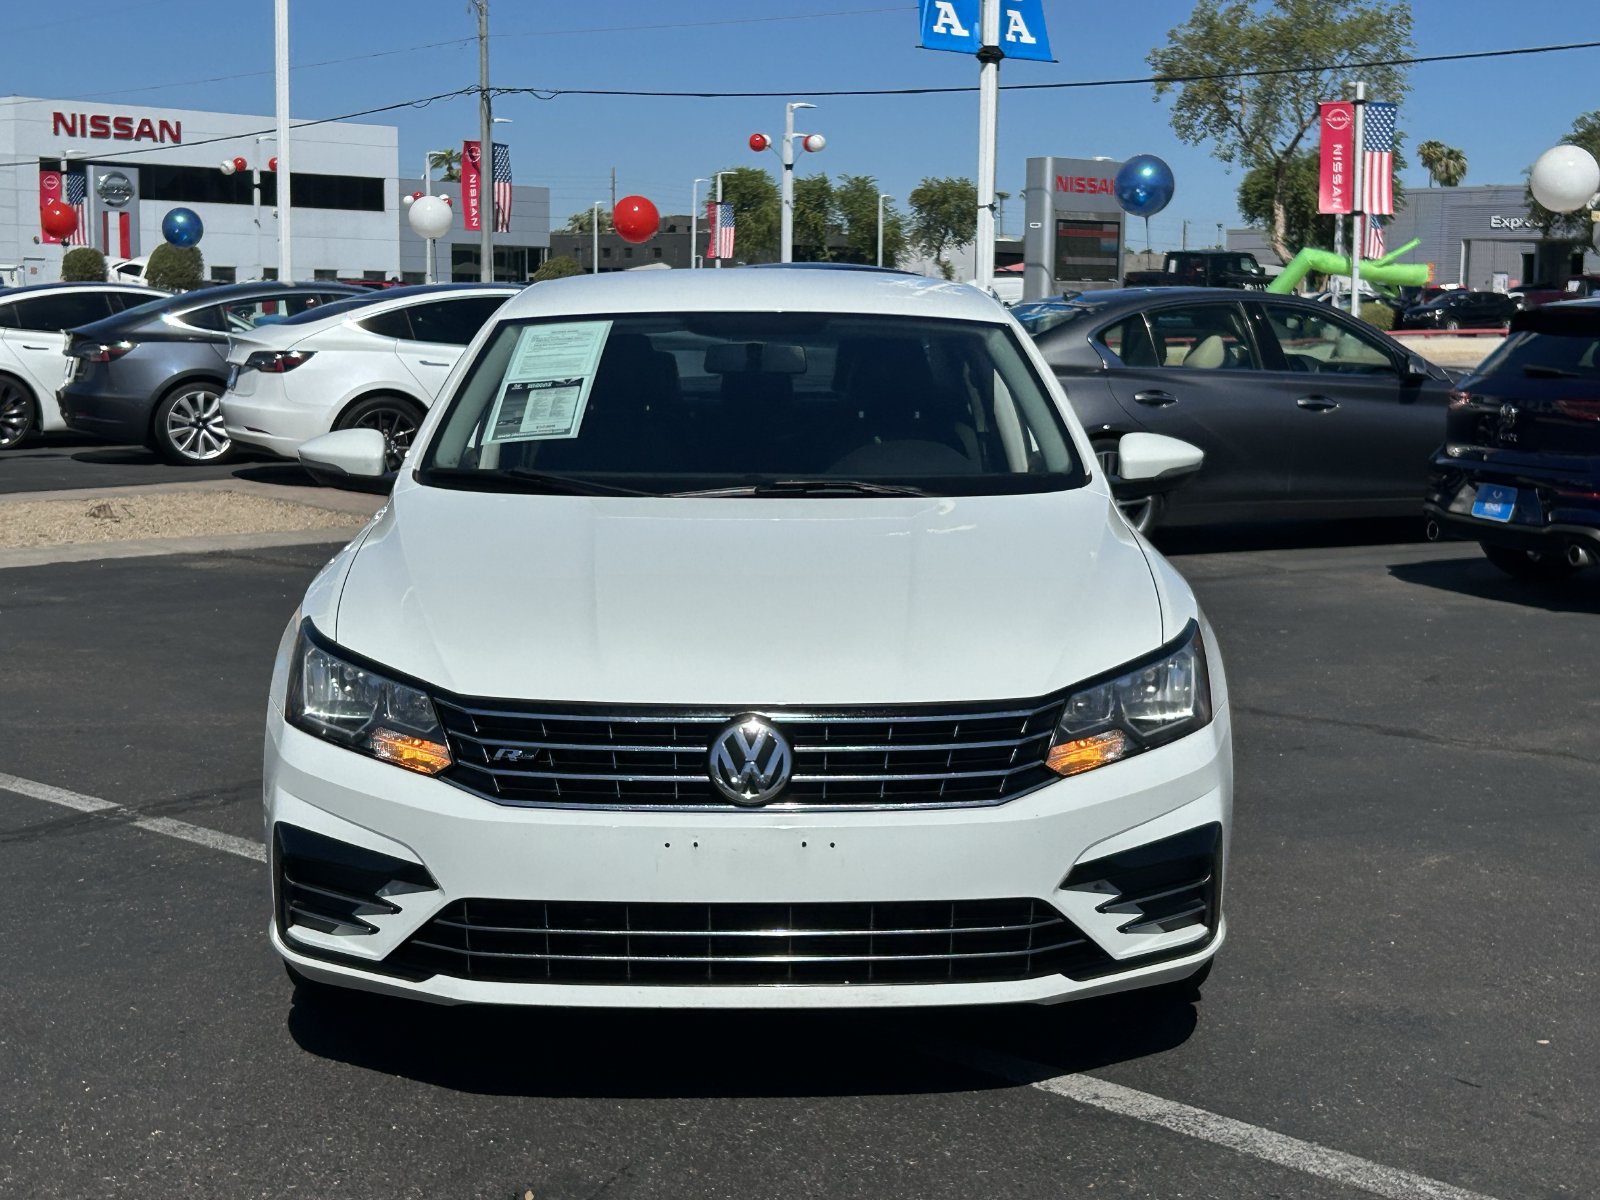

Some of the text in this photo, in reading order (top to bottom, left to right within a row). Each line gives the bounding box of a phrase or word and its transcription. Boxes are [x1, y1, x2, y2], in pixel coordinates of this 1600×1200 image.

[932, 1, 970, 37] A
[1005, 9, 1037, 44] A
[52, 111, 182, 144] NISSAN
[1332, 143, 1344, 209] NISSAN
[469, 174, 479, 227] NISSAN
